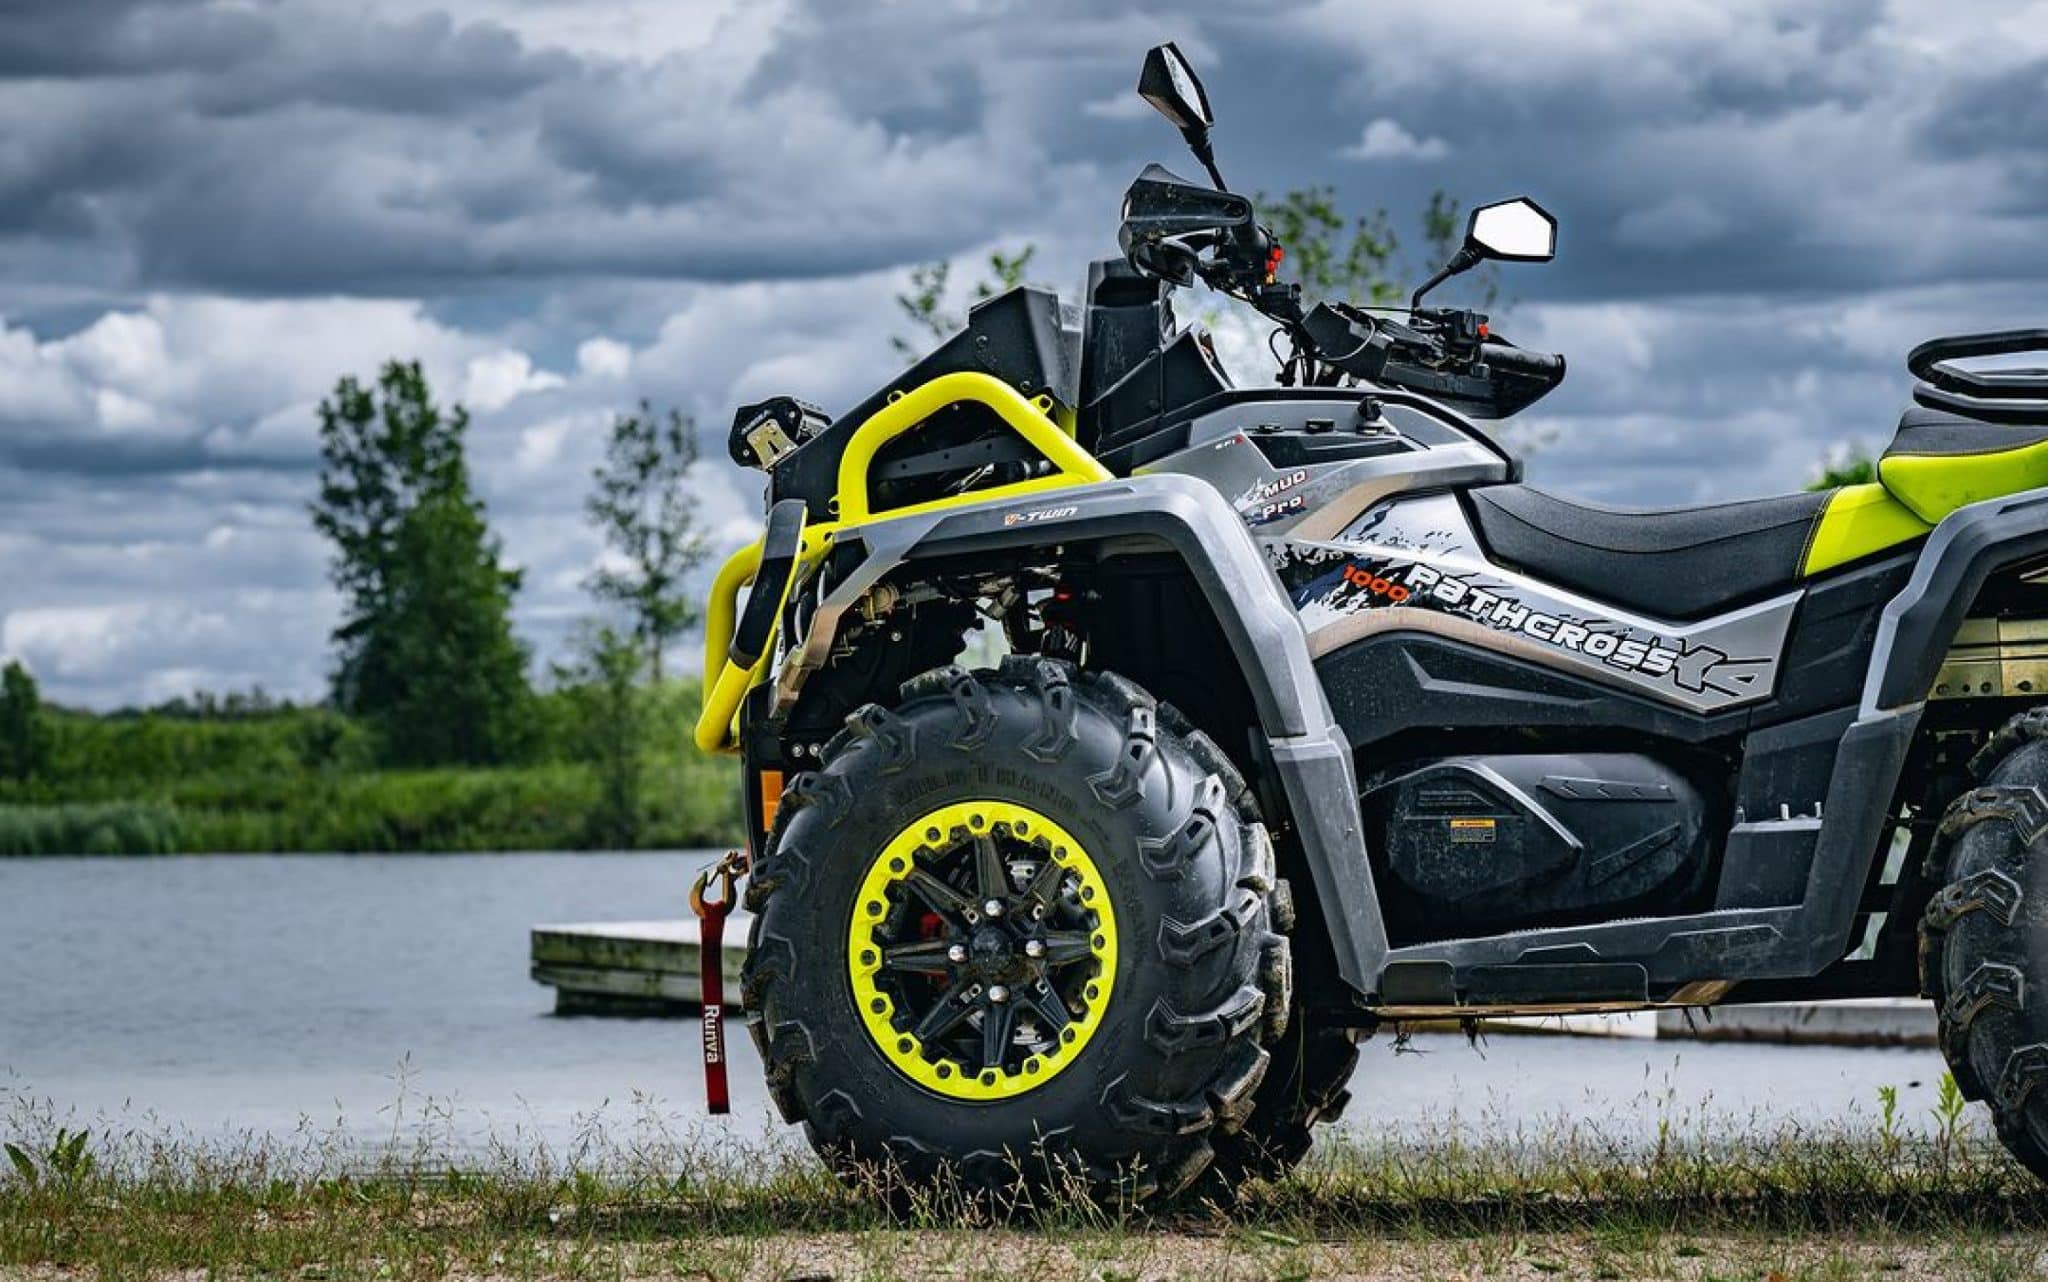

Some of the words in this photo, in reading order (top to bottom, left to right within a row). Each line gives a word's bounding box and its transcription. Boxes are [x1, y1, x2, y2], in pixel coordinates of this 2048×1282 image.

[1263, 469, 1307, 499] MUD
[1342, 565, 1410, 602] 1000
[704, 1004, 720, 1063] Runva
